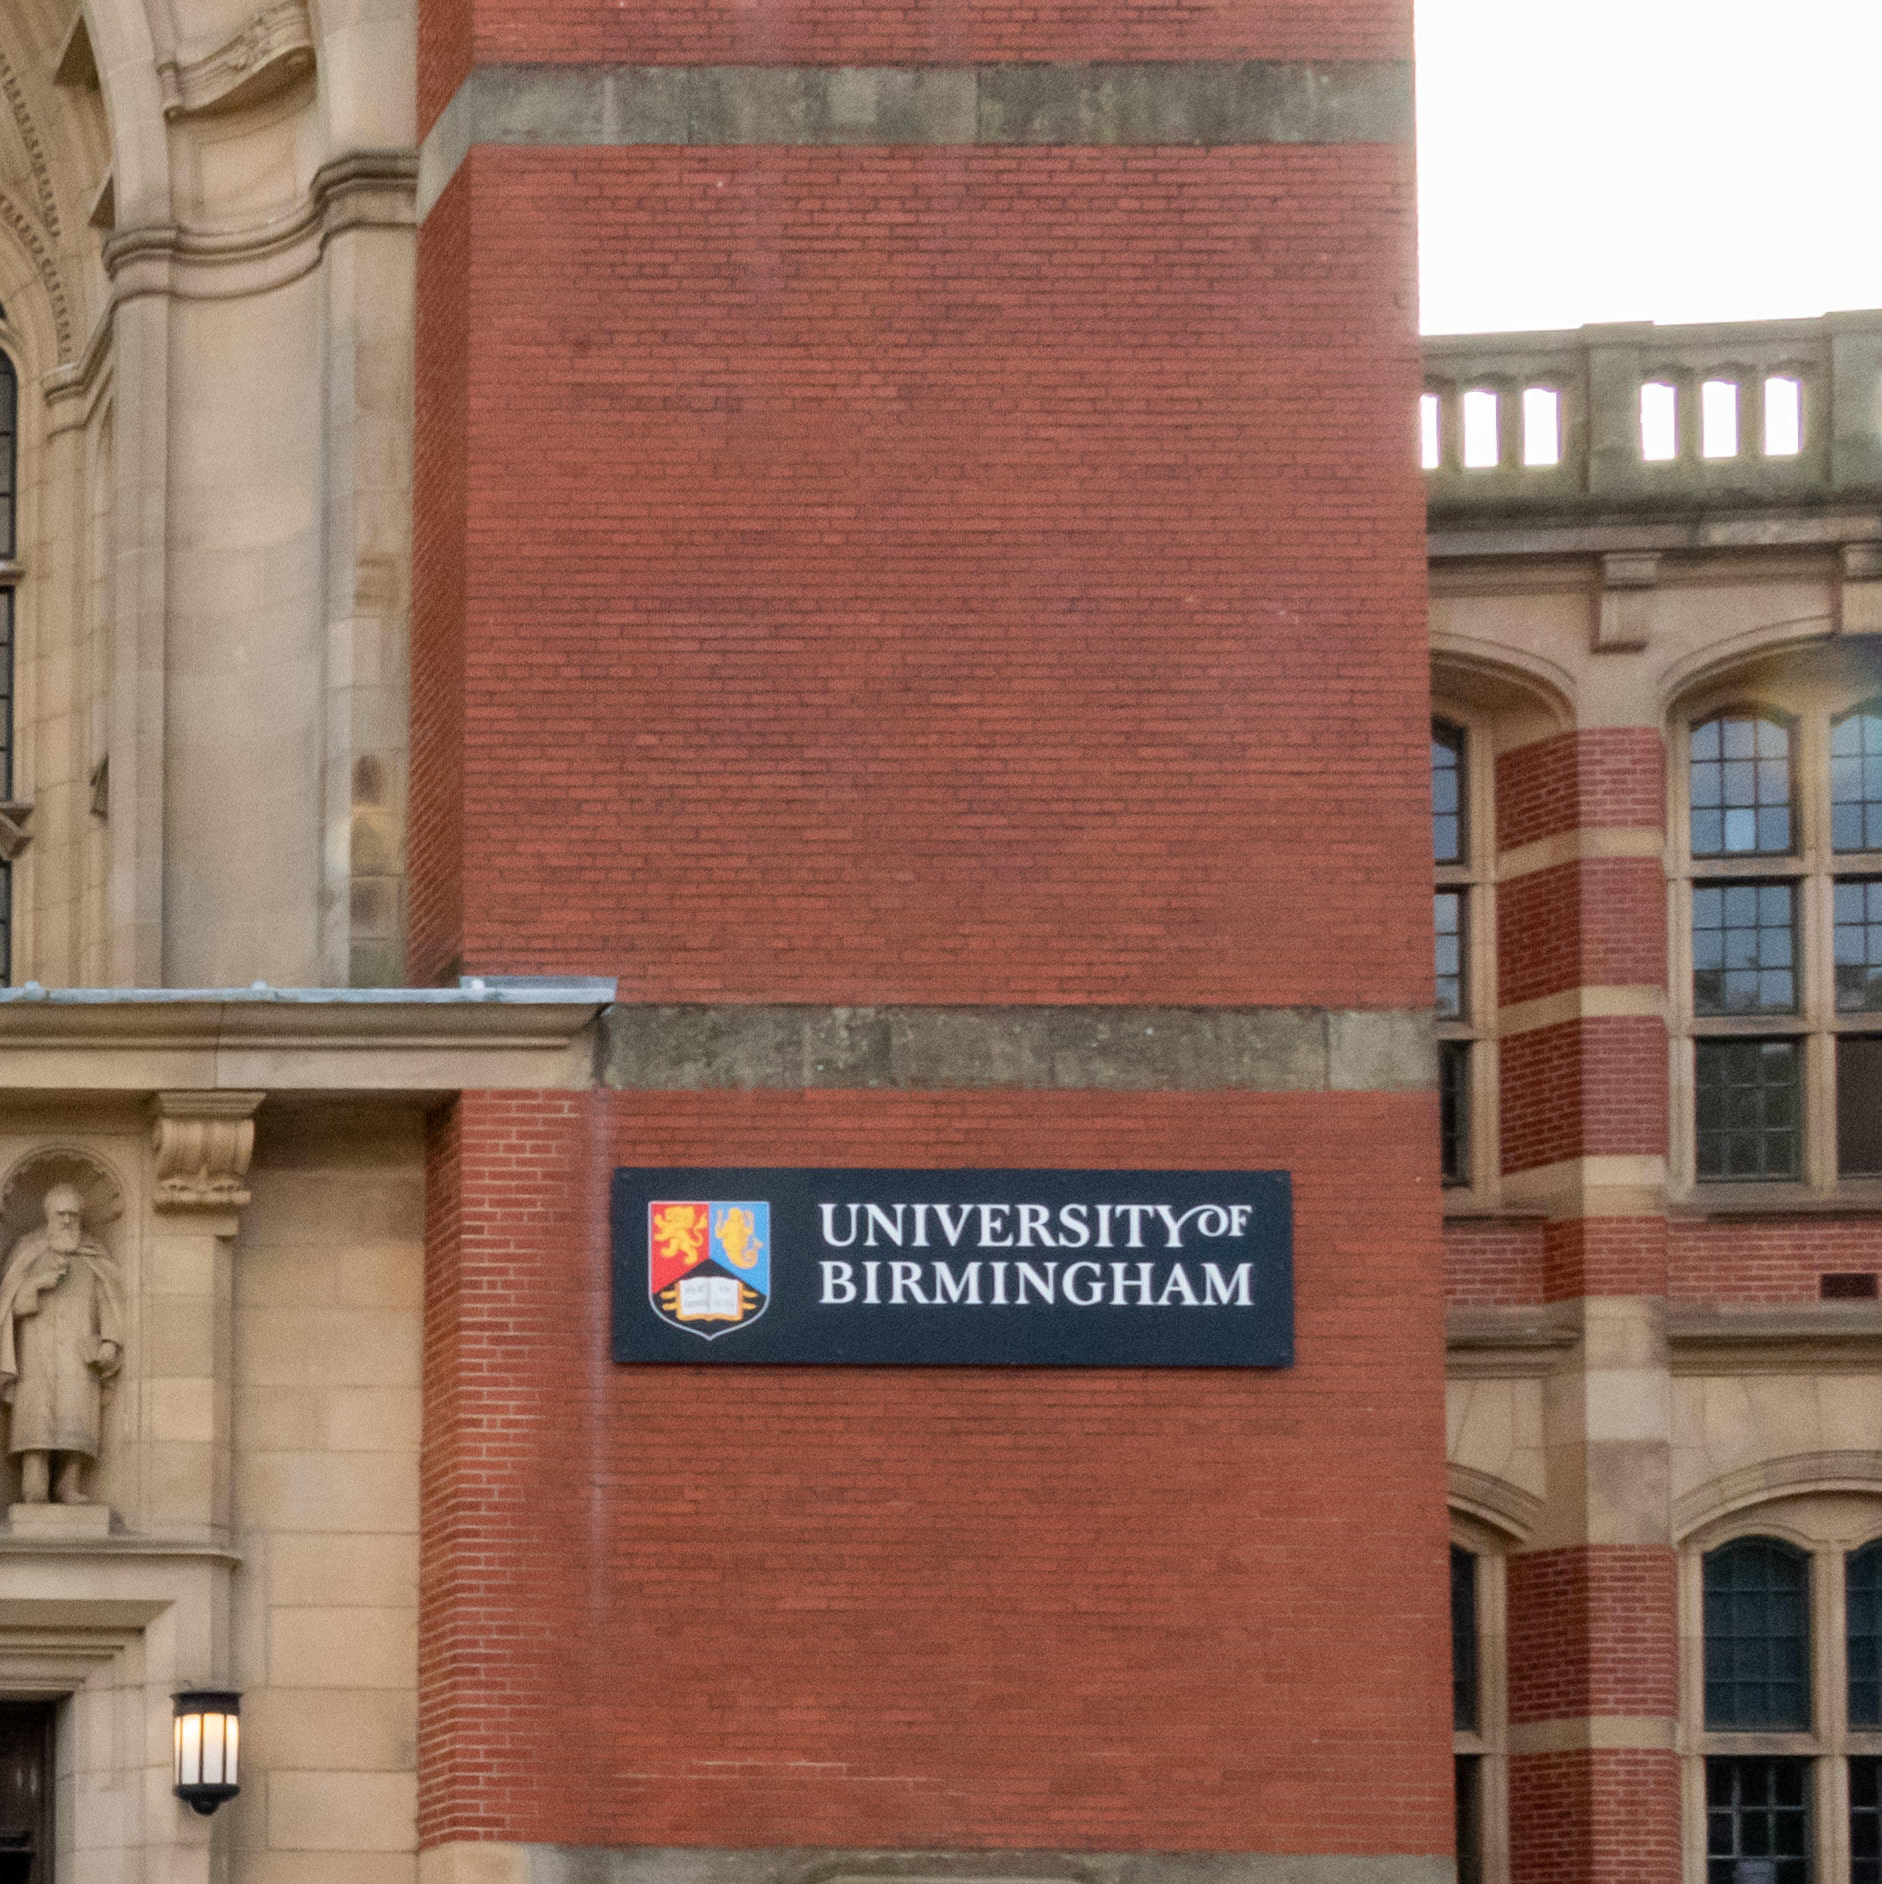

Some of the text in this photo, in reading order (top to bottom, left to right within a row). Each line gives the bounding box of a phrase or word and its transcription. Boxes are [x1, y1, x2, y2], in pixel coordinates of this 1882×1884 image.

[818, 1203, 1253, 1248] UNIVERSITY OF
[818, 1260, 1254, 1306] BIRMINGHAM
